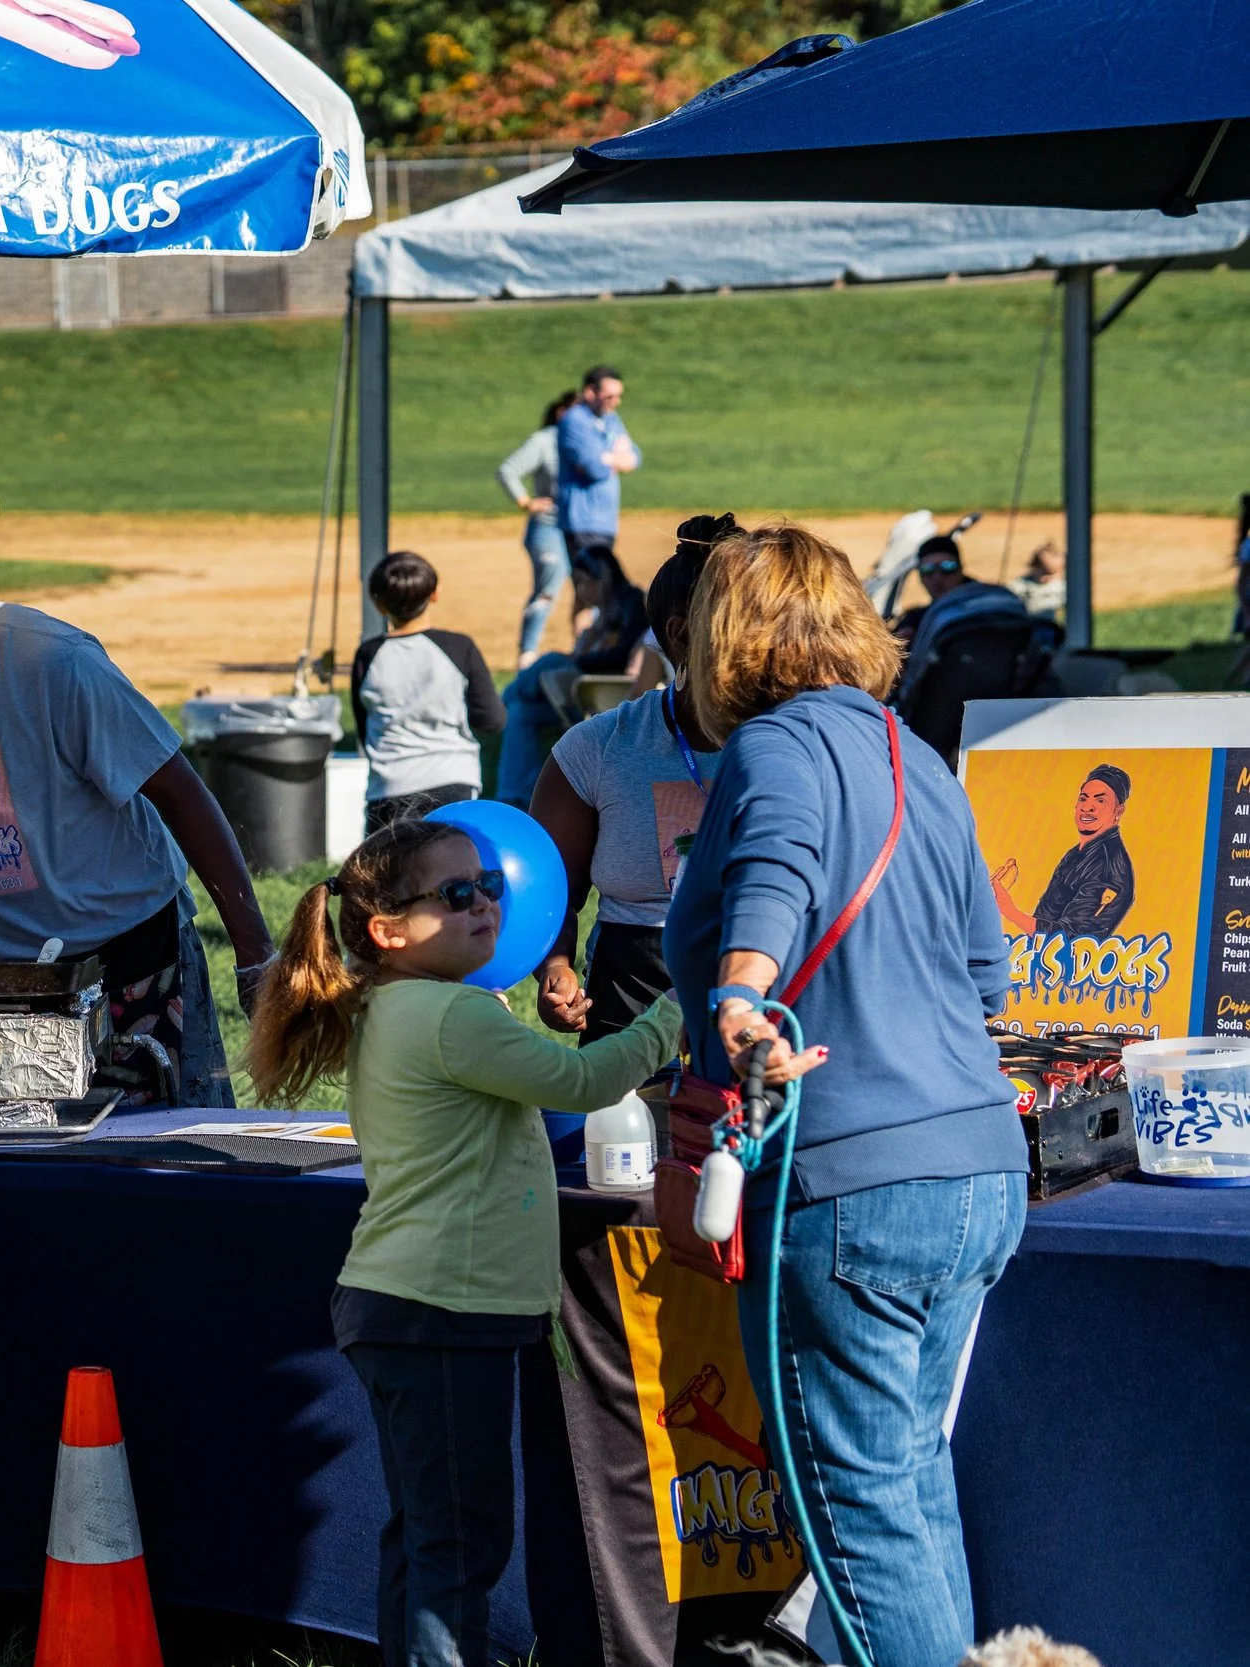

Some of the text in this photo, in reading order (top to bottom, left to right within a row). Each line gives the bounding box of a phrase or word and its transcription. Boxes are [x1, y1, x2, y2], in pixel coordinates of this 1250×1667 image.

[31, 179, 182, 236] DOGS
[1234, 804, 1249, 816] All
[1232, 832, 1247, 844] All
[1070, 934, 1170, 990] DOGS
[1221, 960, 1247, 973] Fruit
[1216, 1018, 1243, 1030] Soda
[1134, 1089, 1174, 1119] Life
